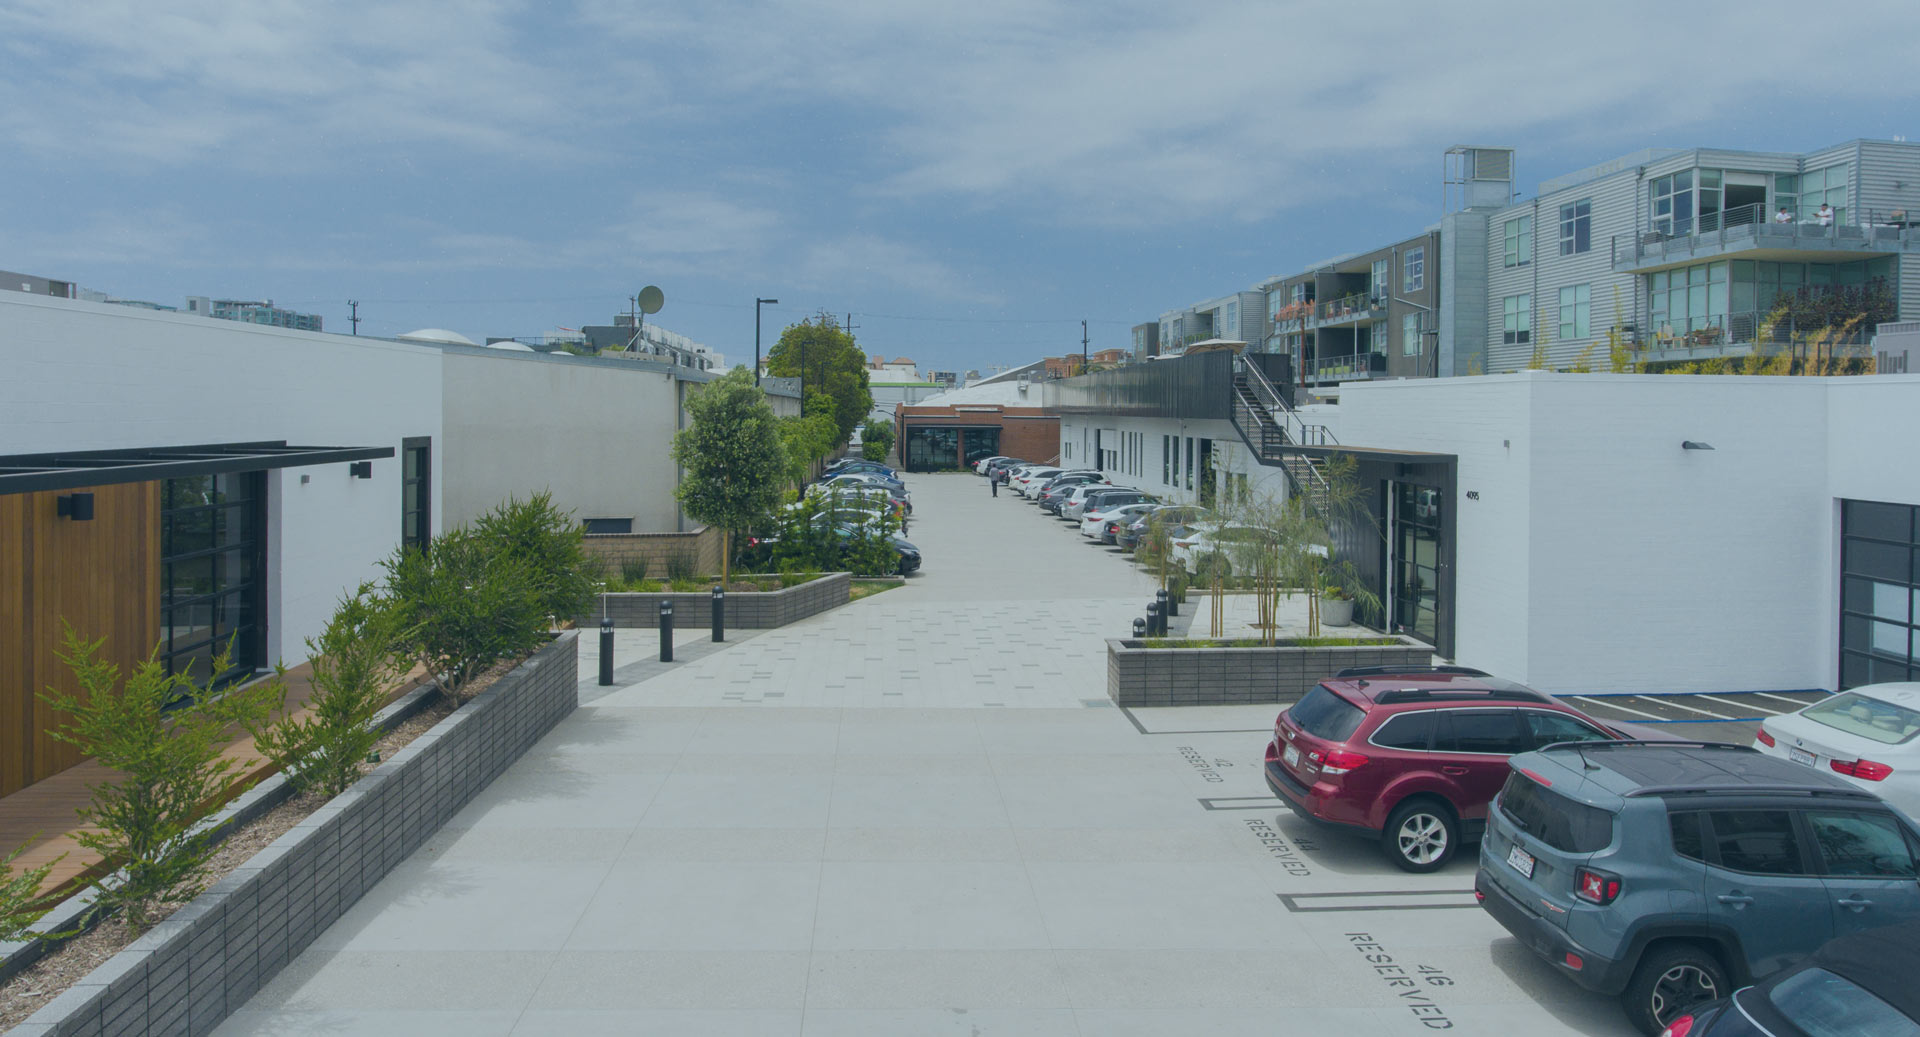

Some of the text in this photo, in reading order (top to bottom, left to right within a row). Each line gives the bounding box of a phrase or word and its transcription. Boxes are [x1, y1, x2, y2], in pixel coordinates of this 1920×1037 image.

[1466, 490, 1480, 501] 4095
[1176, 746, 1224, 783] RESERVED
[1243, 819, 1311, 877] RESERVED
[1344, 932, 1453, 1029] RESERVED
[1418, 965, 1454, 986] 46
